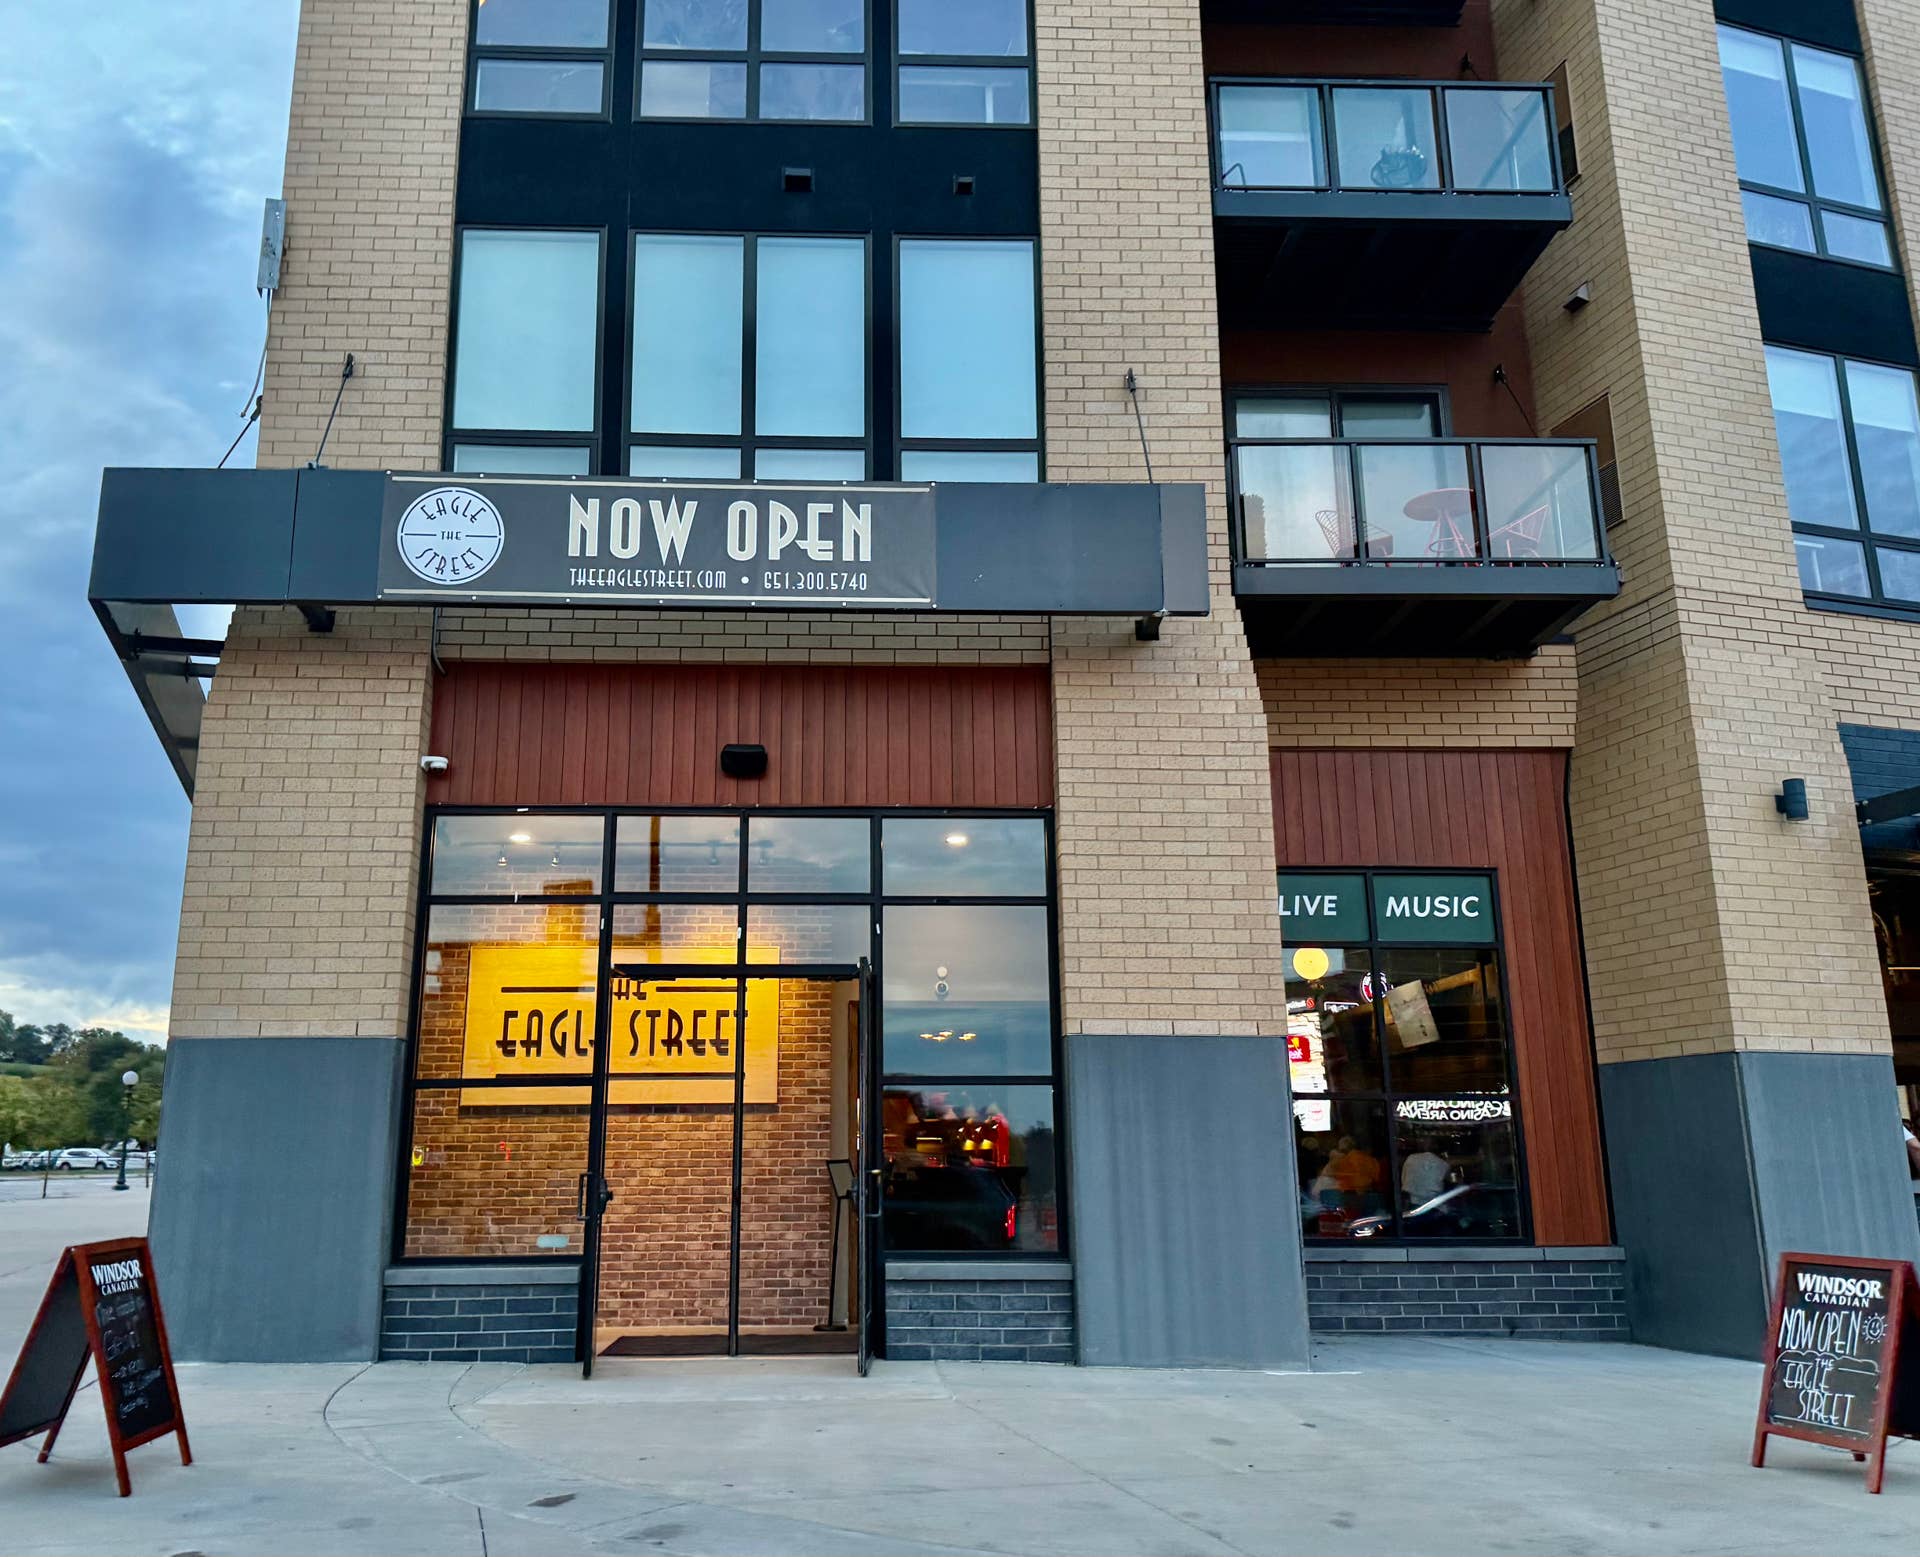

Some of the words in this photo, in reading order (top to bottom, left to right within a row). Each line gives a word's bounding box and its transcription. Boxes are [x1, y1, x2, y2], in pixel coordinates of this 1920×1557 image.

[420, 496, 487, 524] EAGLE
[440, 531, 462, 541] THE
[567, 493, 698, 566] NOW
[726, 498, 872, 562] OPEN
[415, 547, 484, 575] STREET
[569, 567, 727, 589] THEEAGLESTREET.COM
[764, 571, 868, 591] 651.300.5740
[1278, 895, 1338, 916] LIVE
[1385, 895, 1480, 918] MUSIC
[613, 978, 647, 1000] HE
[496, 1009, 595, 1057] EAGL
[91, 1259, 143, 1286] WINDSOR
[101, 1280, 139, 1296] CANADIAN
[1797, 1273, 1884, 1299] WINDSOR
[1804, 1292, 1870, 1308] CANADIAN
[1778, 1307, 1819, 1350] NOW
[1818, 1310, 1862, 1356] OPEN
[1814, 1358, 1834, 1369] THE
[1783, 1363, 1832, 1394] EAGLE
[1797, 1390, 1855, 1427] STREET
